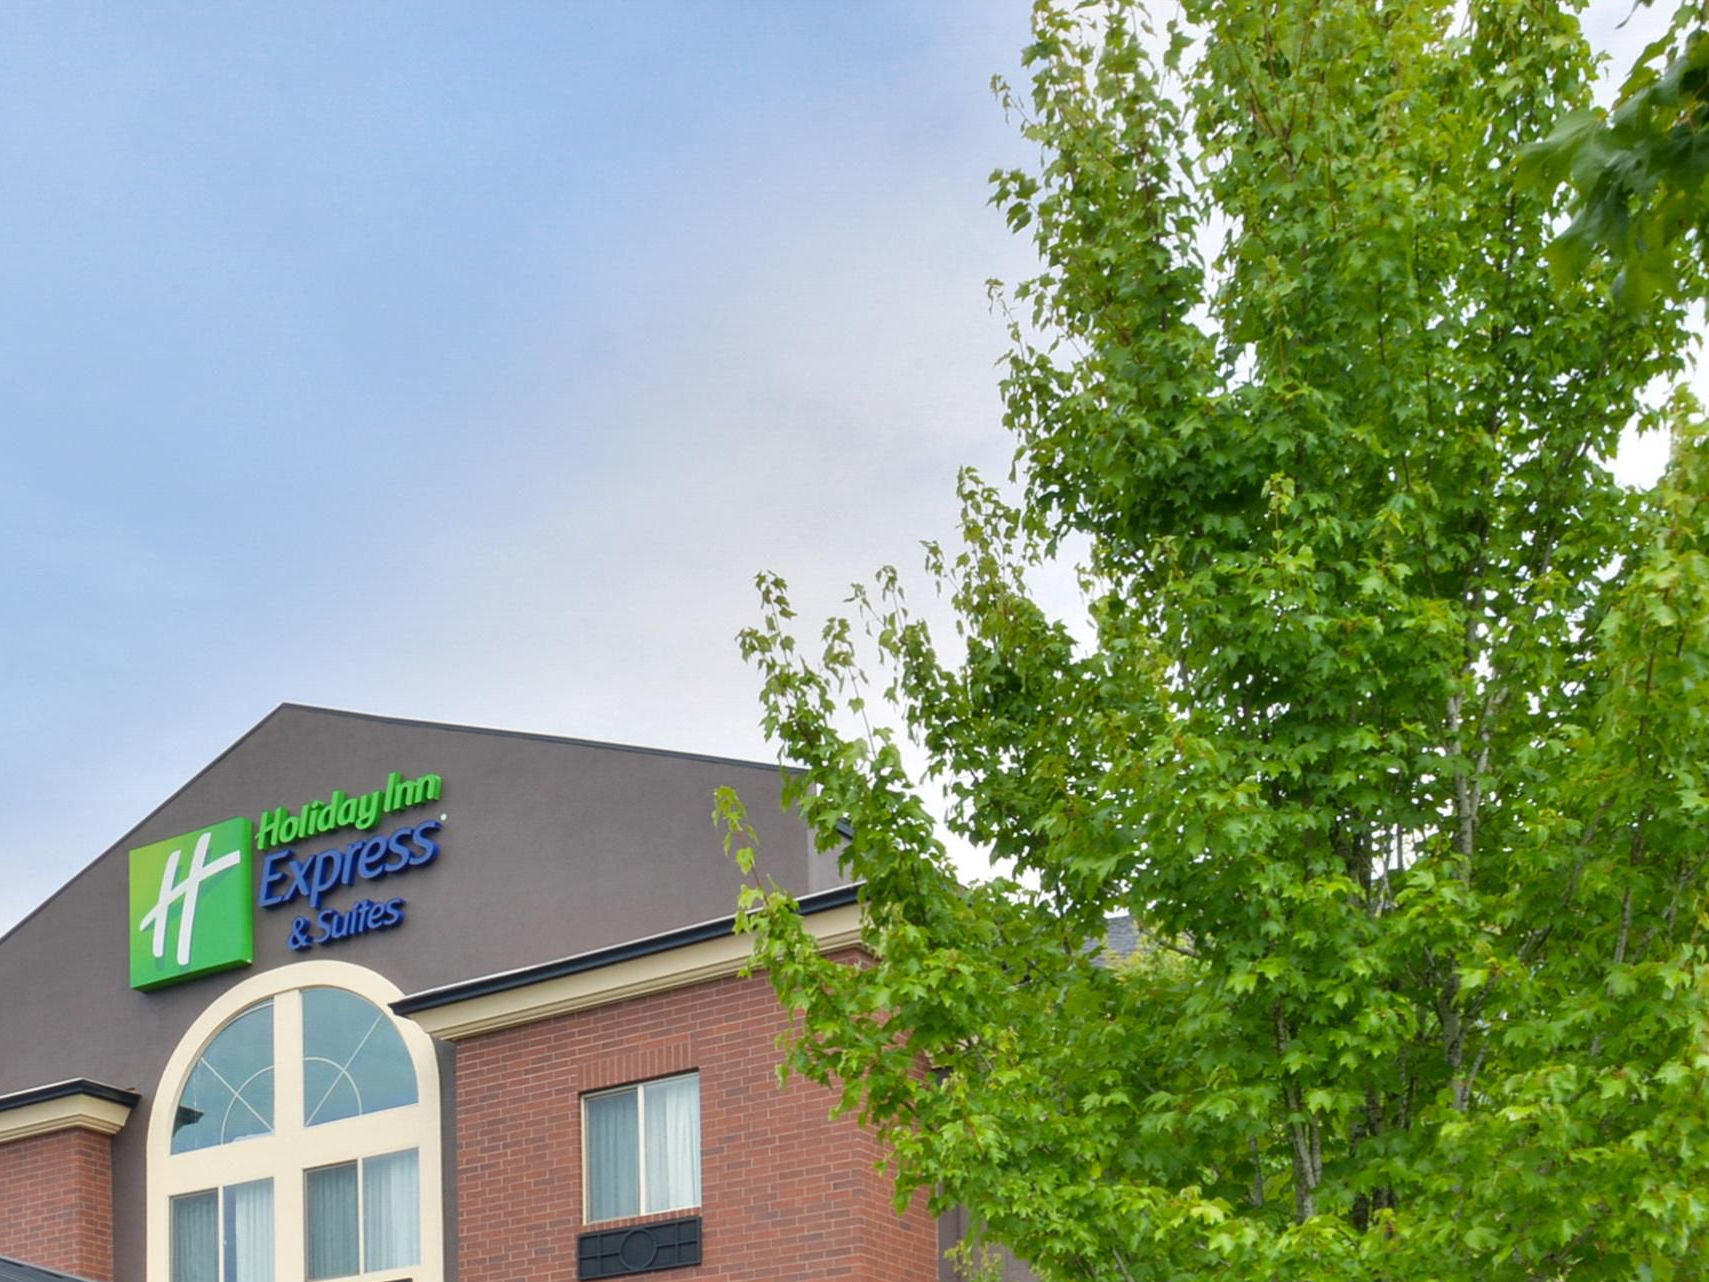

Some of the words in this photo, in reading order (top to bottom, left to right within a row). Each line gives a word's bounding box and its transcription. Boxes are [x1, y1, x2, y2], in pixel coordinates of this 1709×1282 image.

[255, 791, 384, 850] Holiday
[383, 771, 441, 813] Inn
[258, 819, 442, 909] Express
[287, 915, 313, 950] &
[314, 897, 405, 944] Suites
